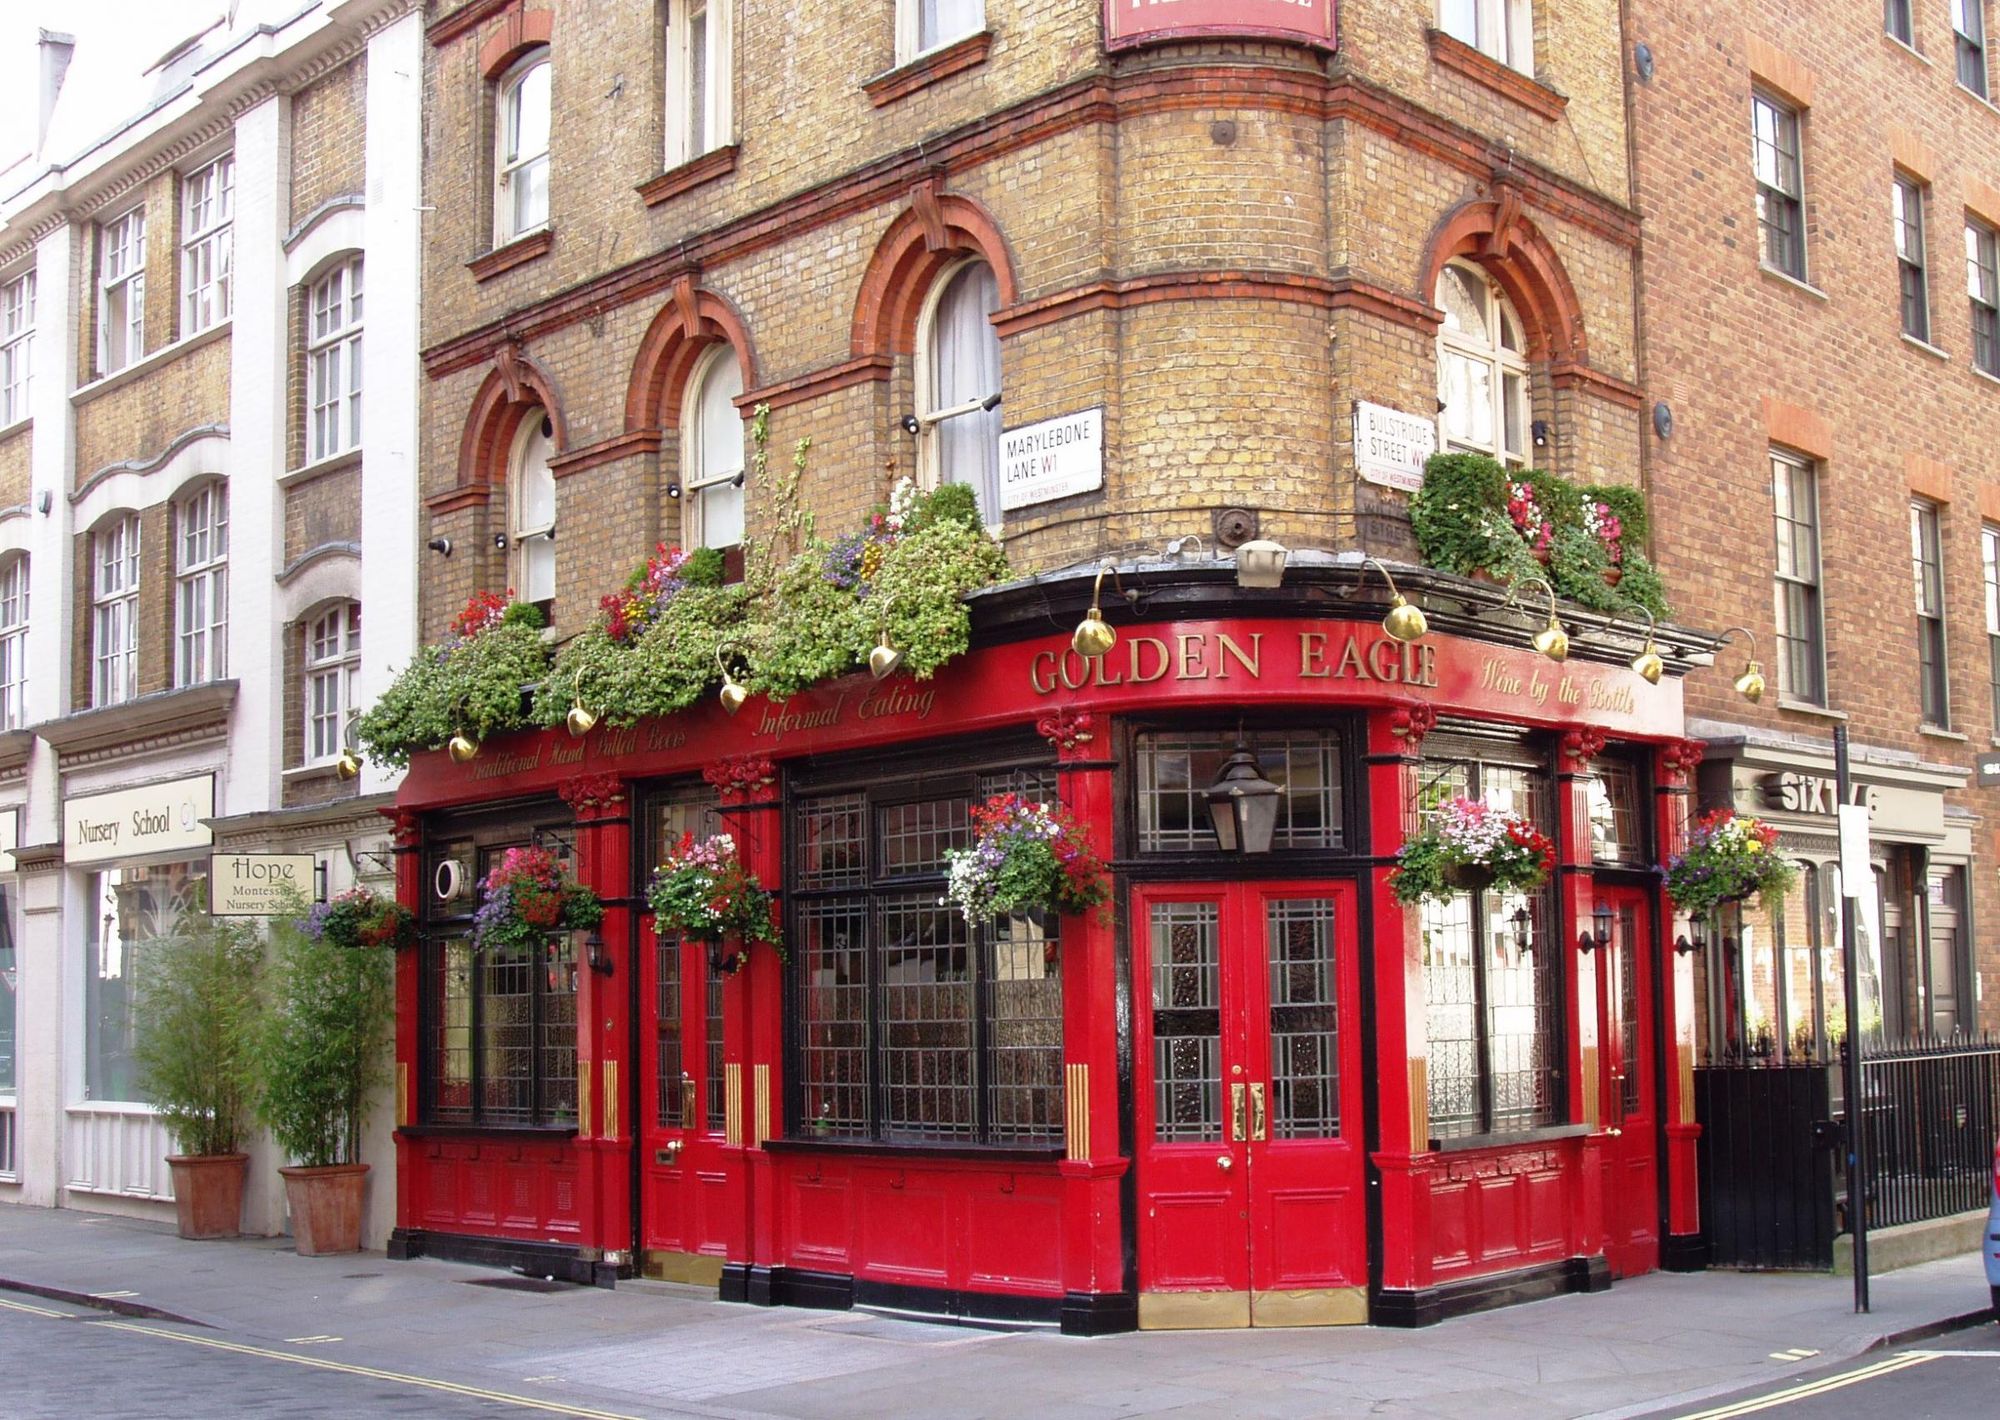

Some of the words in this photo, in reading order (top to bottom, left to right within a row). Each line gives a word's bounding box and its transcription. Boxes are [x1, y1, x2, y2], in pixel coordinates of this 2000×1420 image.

[1007, 420, 1090, 459] MARYLEBONE
[1369, 412, 1428, 446] BULSTRODE
[1007, 459, 1037, 483] LANE
[1042, 453, 1057, 474] W1
[1370, 436, 1407, 464] STREET
[1411, 448, 1424, 469] W1
[1007, 494, 1019, 505] CITY
[1030, 480, 1069, 499] WESTMINSTER
[1030, 634, 1264, 695] GOLDEN
[1298, 632, 1438, 688] EAGLE
[1481, 656, 1522, 696] Wine
[1530, 668, 1549, 706] by
[1558, 675, 1580, 705] the
[1588, 678, 1635, 715] Bottle
[752, 693, 844, 741] Informal
[858, 684, 936, 720] Eating
[466, 743, 541, 782] Traditional
[546, 738, 586, 767] Hand
[593, 727, 637, 759] Pulled
[647, 723, 688, 752] Beers
[78, 819, 120, 846] Nursery
[132, 806, 170, 836] School
[232, 858, 295, 883] Hope
[226, 899, 265, 911] Nursery
[267, 899, 304, 912] Scho
[233, 886, 296, 896] Montesso
